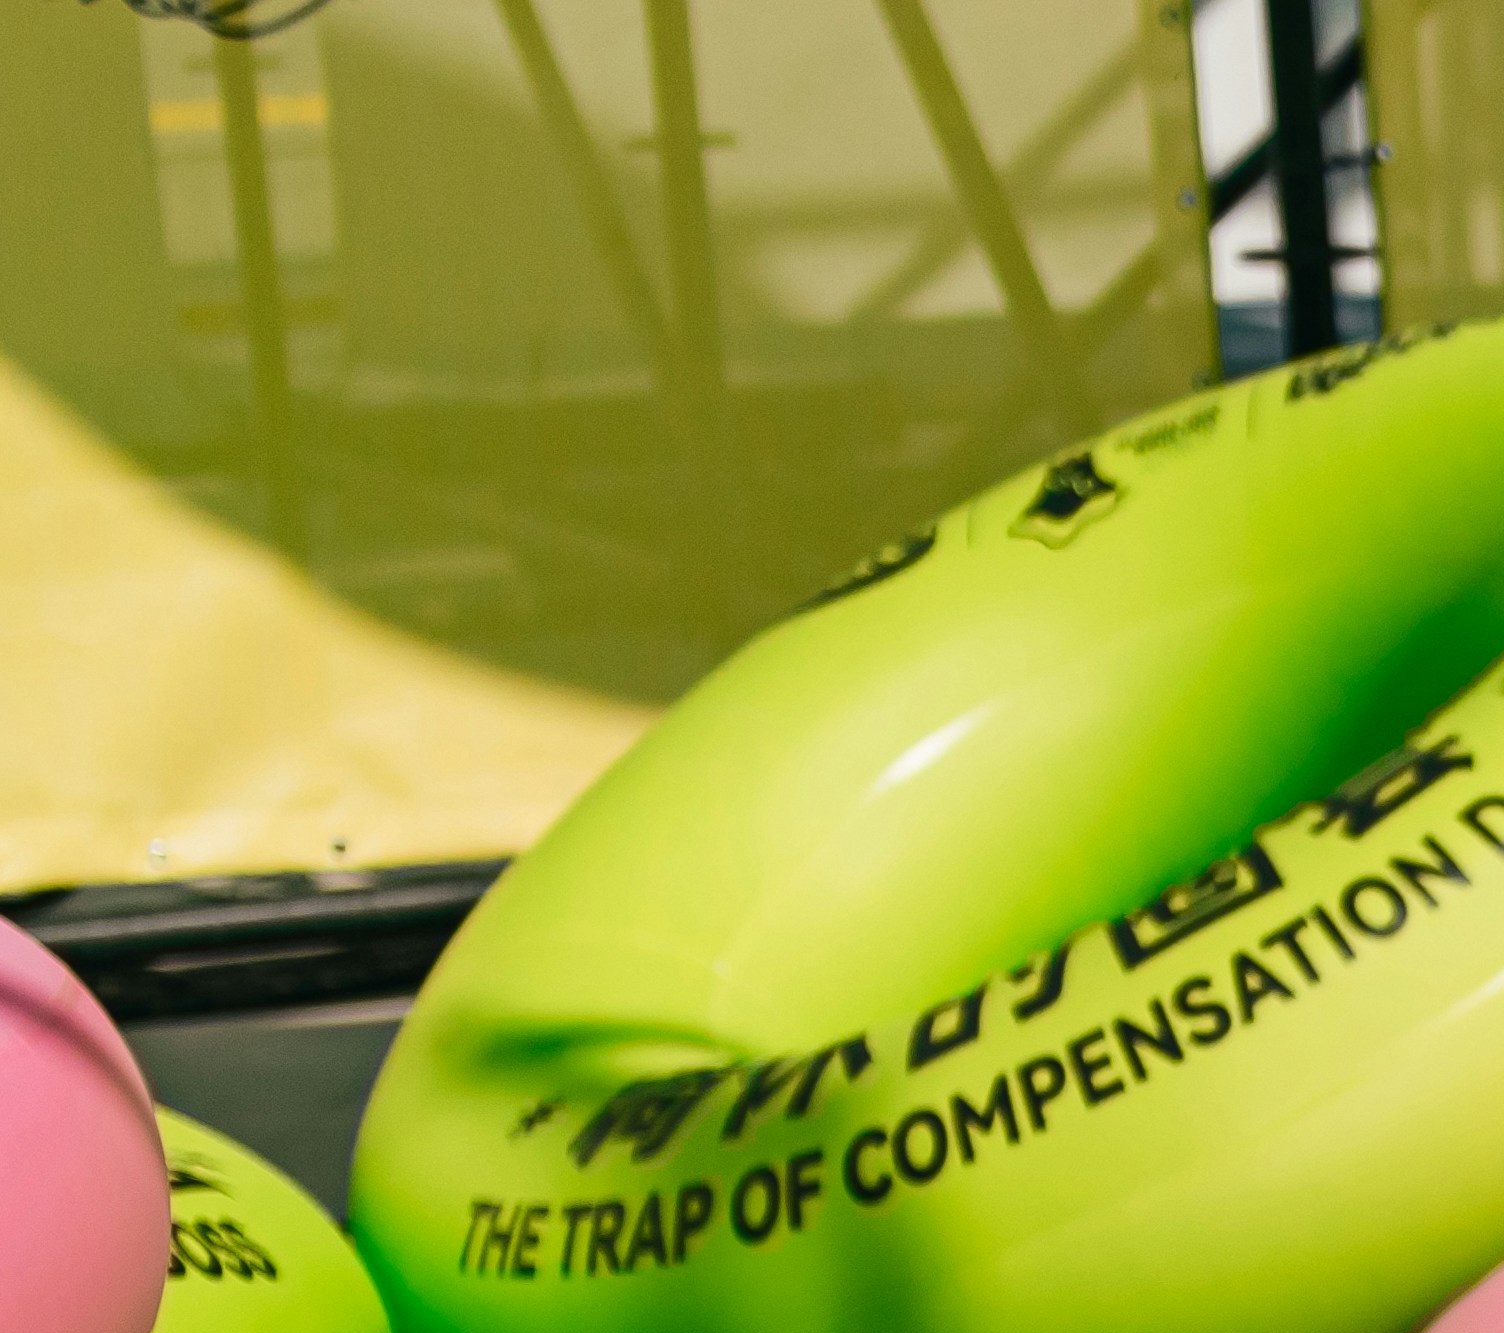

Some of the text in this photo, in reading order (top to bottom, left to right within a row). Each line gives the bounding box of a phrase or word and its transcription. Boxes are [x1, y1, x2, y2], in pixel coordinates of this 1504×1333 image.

[459, 1198, 549, 1280] THE
[559, 1180, 716, 1279] TRAP
[729, 1148, 826, 1246] OF
[842, 833, 1472, 1206] COMPENSATION
[167, 1221, 279, 1281] OSS
